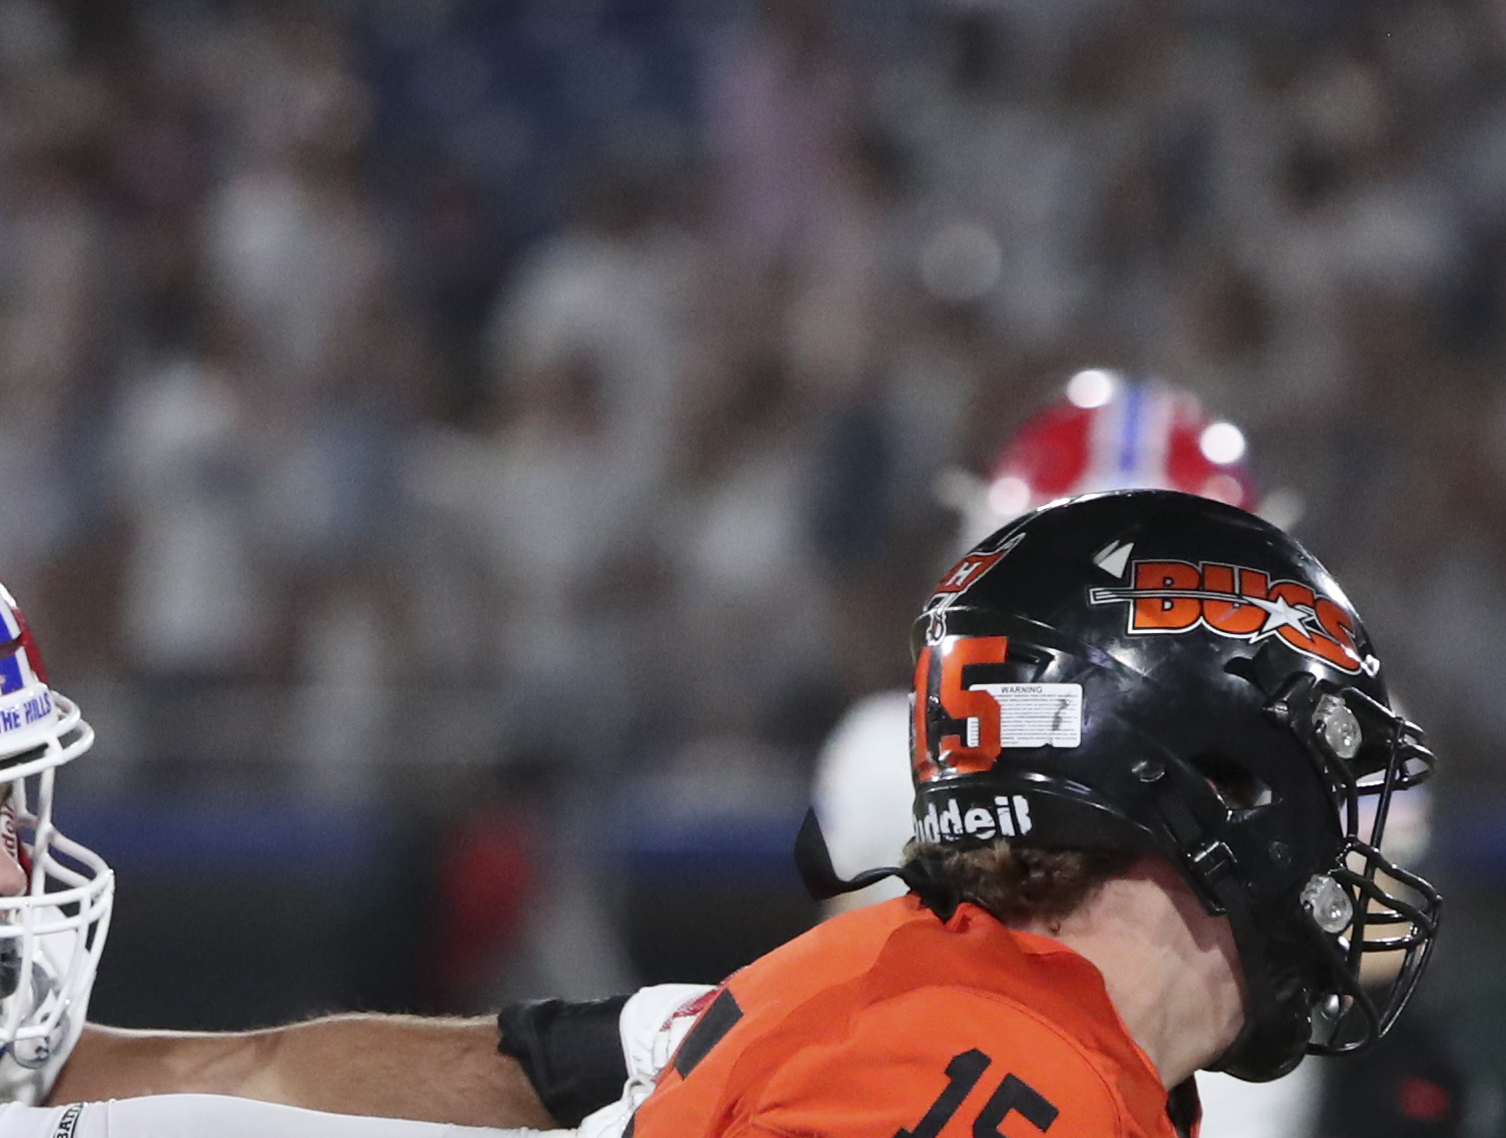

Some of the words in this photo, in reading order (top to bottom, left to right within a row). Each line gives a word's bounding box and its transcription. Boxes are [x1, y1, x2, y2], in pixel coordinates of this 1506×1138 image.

[944, 561, 983, 587] H
[1128, 560, 1363, 675] BUCS
[913, 636, 1008, 782] 15
[1001, 686, 1043, 694] WARNING
